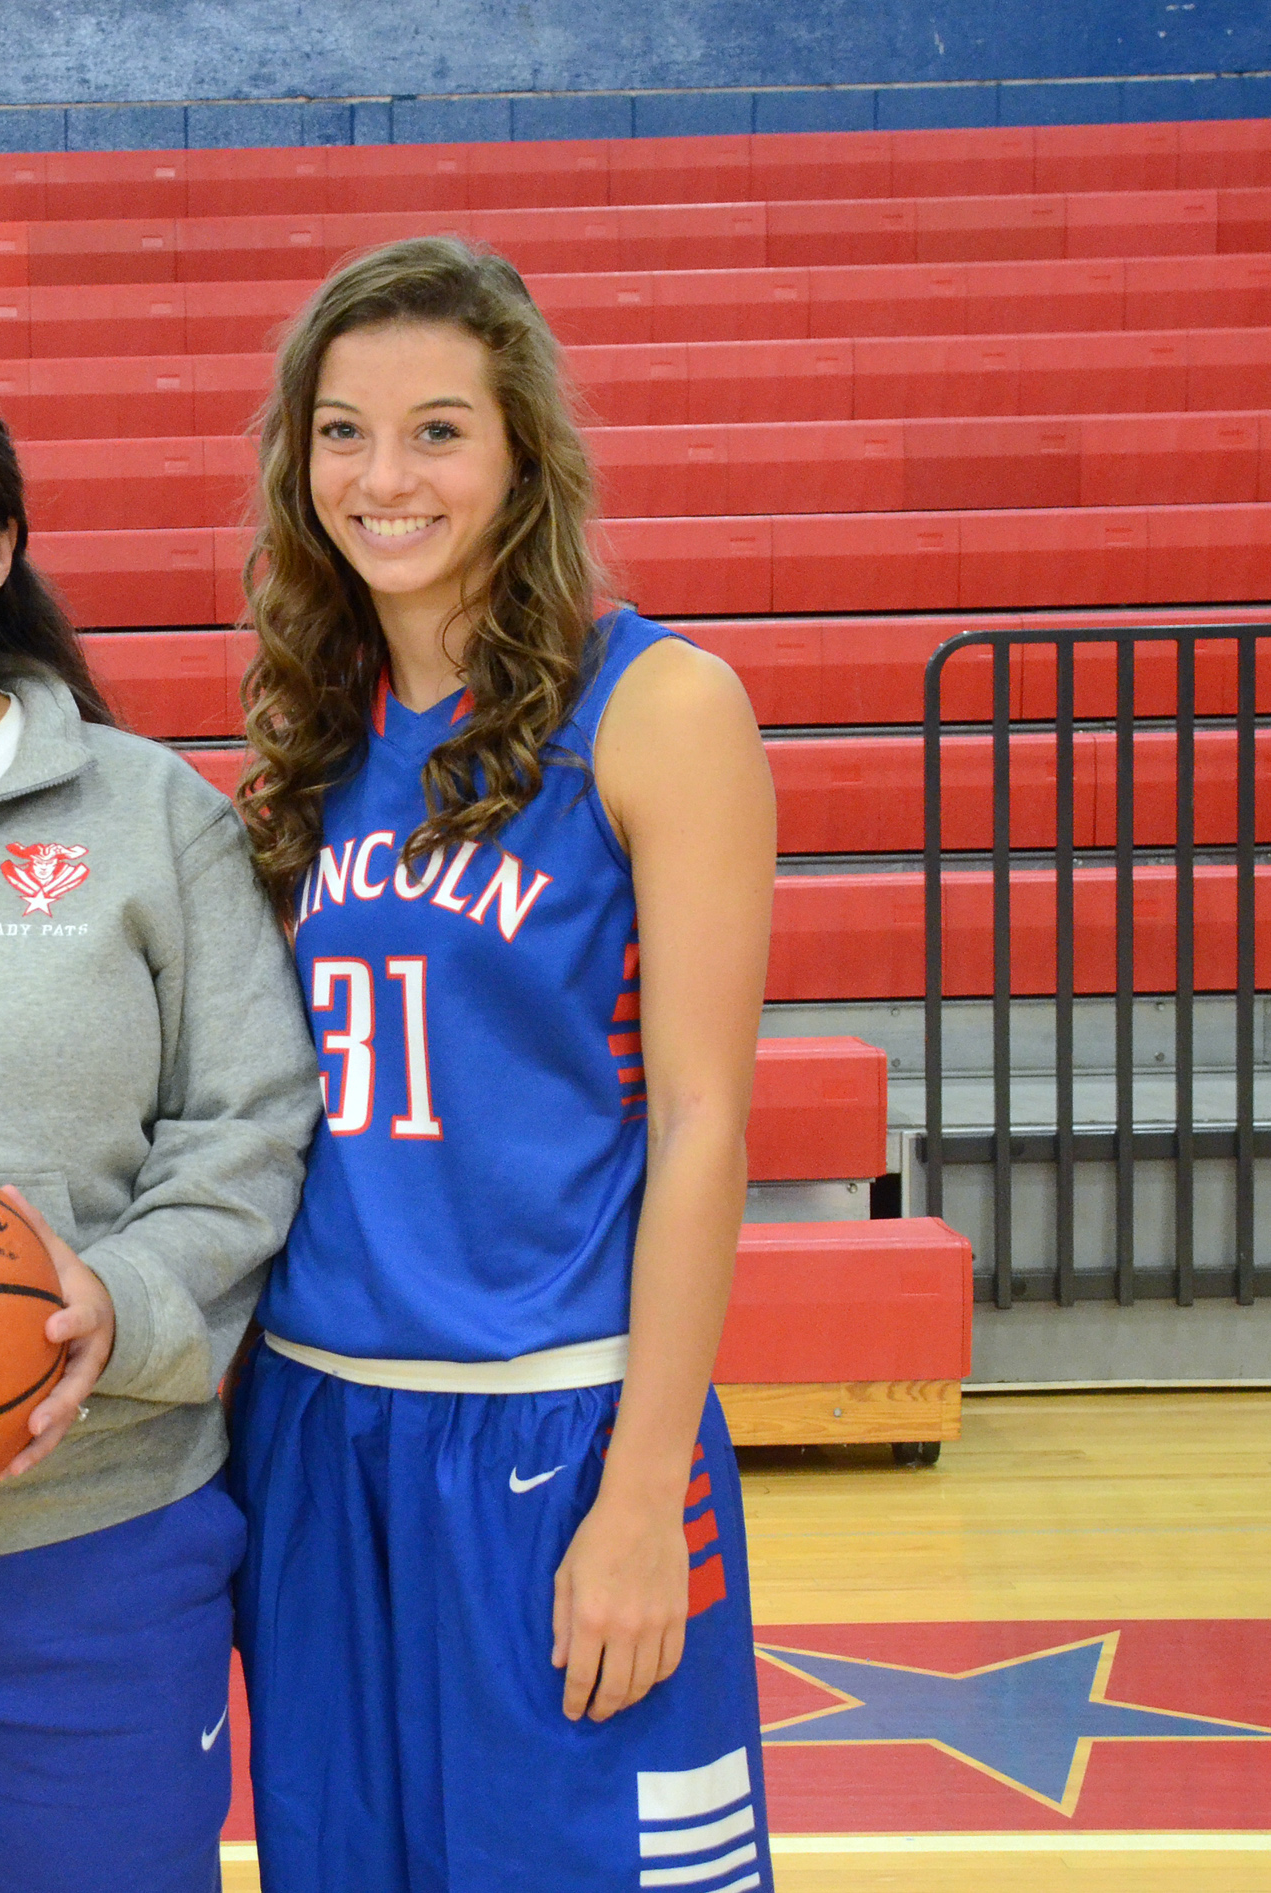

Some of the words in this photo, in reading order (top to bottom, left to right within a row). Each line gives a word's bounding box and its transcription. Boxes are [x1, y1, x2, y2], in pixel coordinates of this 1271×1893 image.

[42, 923, 88, 936] PATS
[293, 830, 554, 943] INCOLN
[312, 955, 444, 1141] 31
